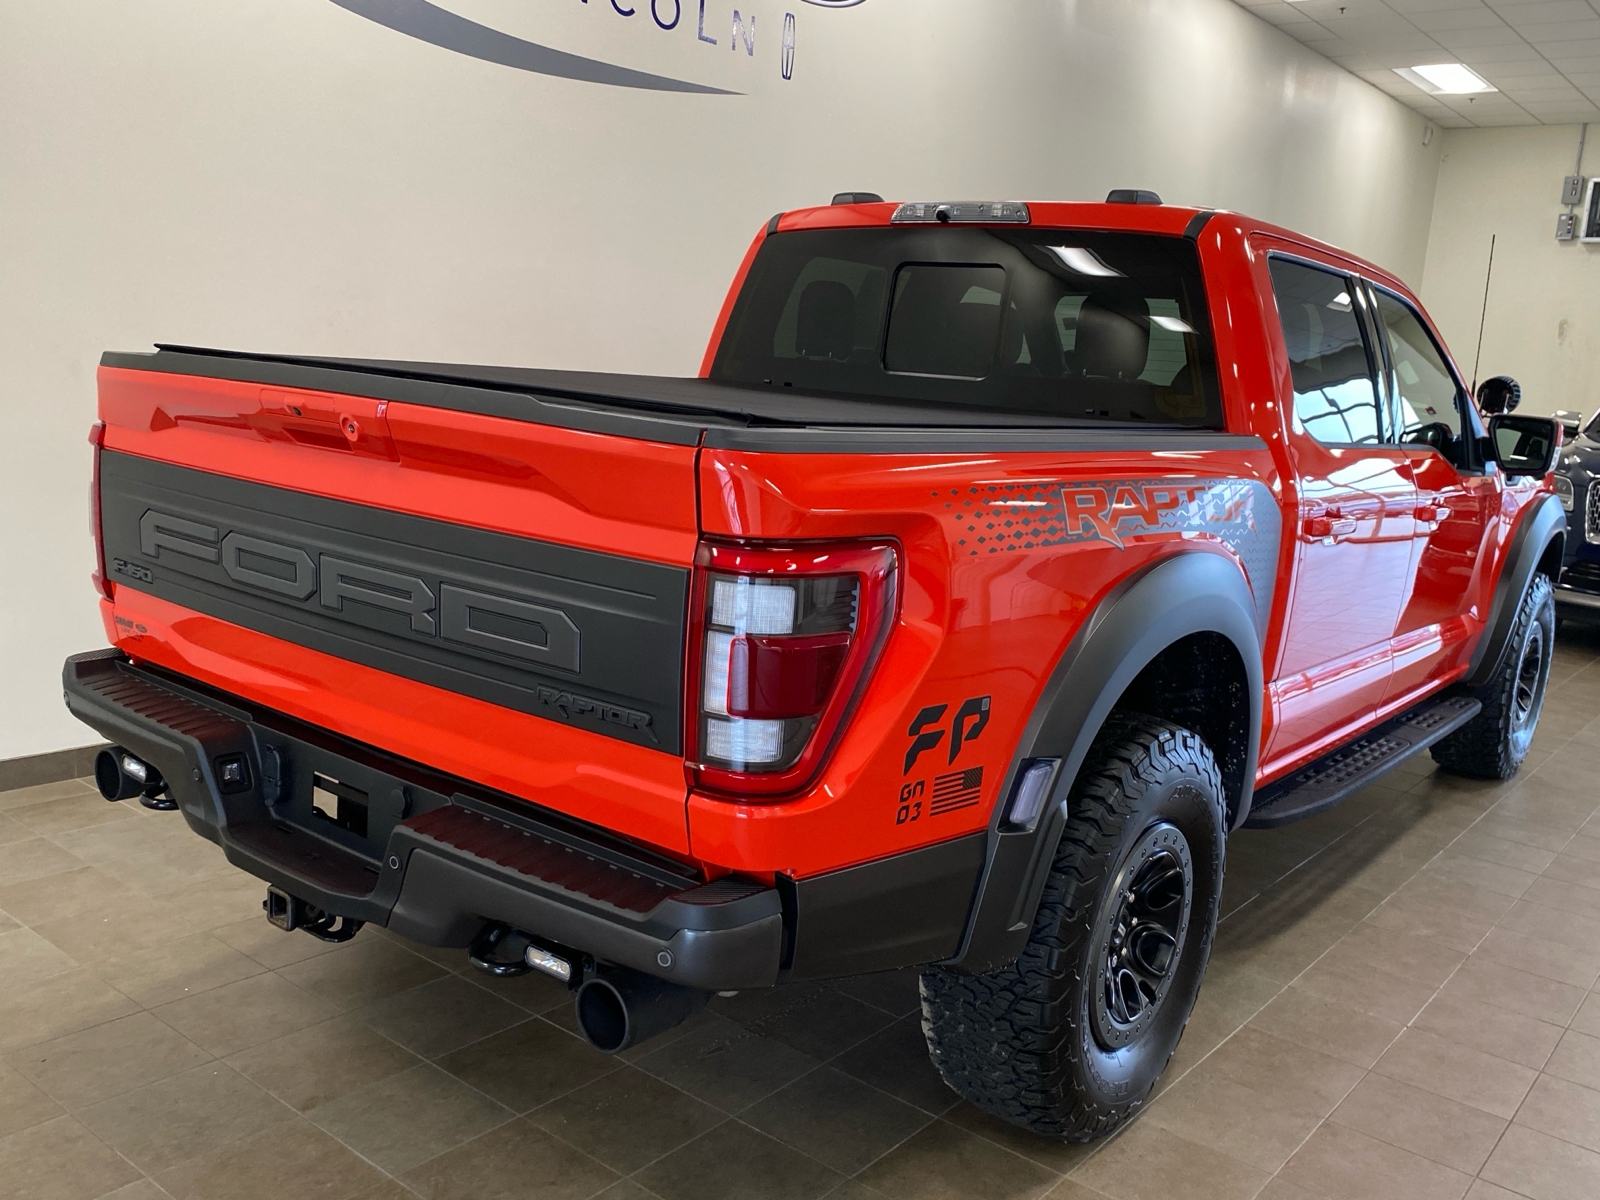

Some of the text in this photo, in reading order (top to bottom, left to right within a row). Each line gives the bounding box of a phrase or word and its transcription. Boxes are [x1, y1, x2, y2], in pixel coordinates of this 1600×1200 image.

[1060, 484, 1258, 551] RAPTOR
[138, 507, 582, 675] FORD
[536, 683, 659, 744] RAPTOR
